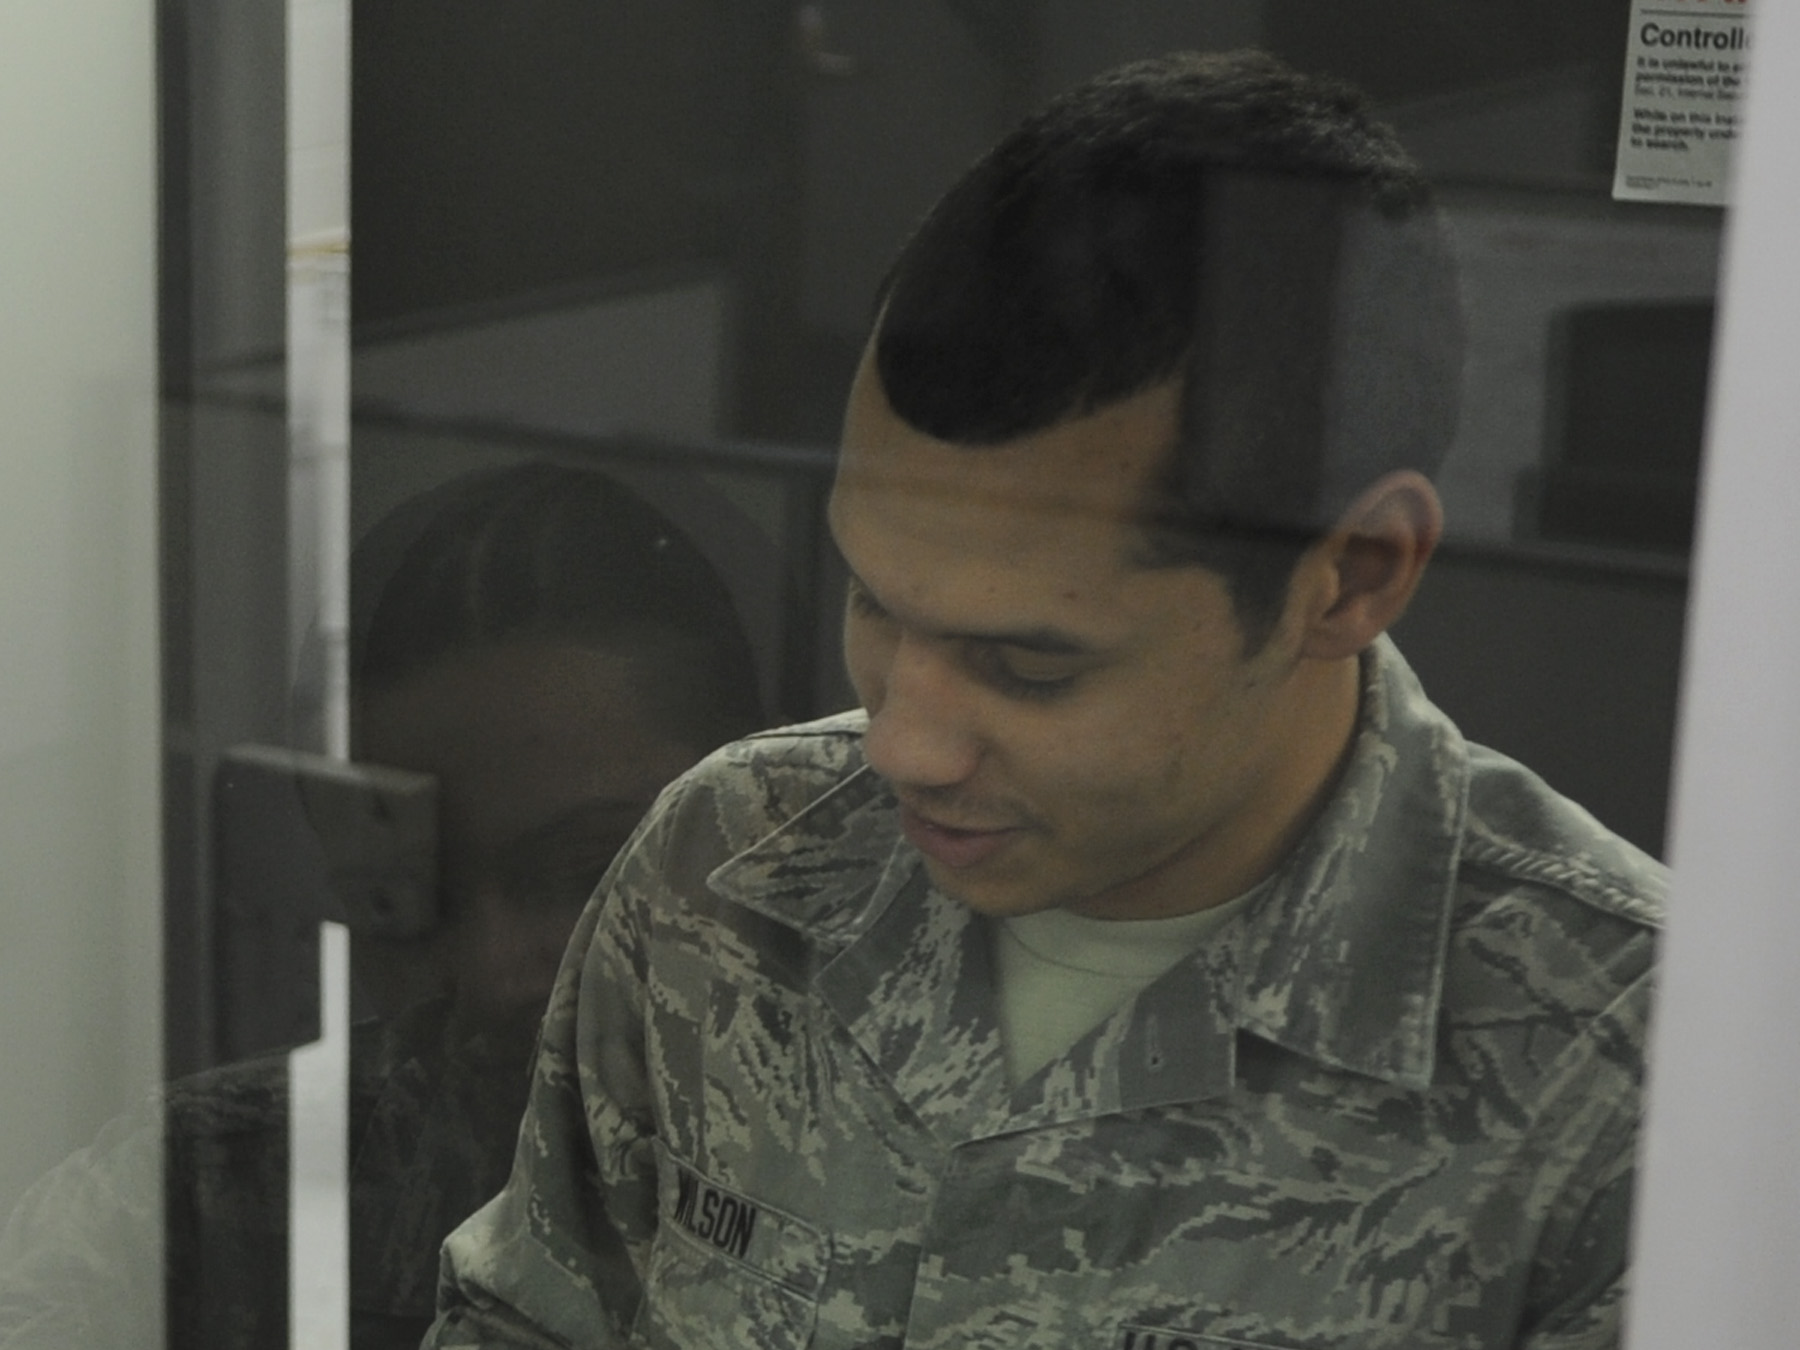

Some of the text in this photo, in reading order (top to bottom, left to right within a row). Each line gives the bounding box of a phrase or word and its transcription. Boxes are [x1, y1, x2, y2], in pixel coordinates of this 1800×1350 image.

[1662, 57, 1715, 71] unlawful
[1636, 72, 1704, 85] permission
[1633, 108, 1667, 121] While
[1670, 111, 1686, 123] on
[1689, 112, 1712, 124] this
[1631, 123, 1651, 134] the
[1654, 125, 1704, 140] property
